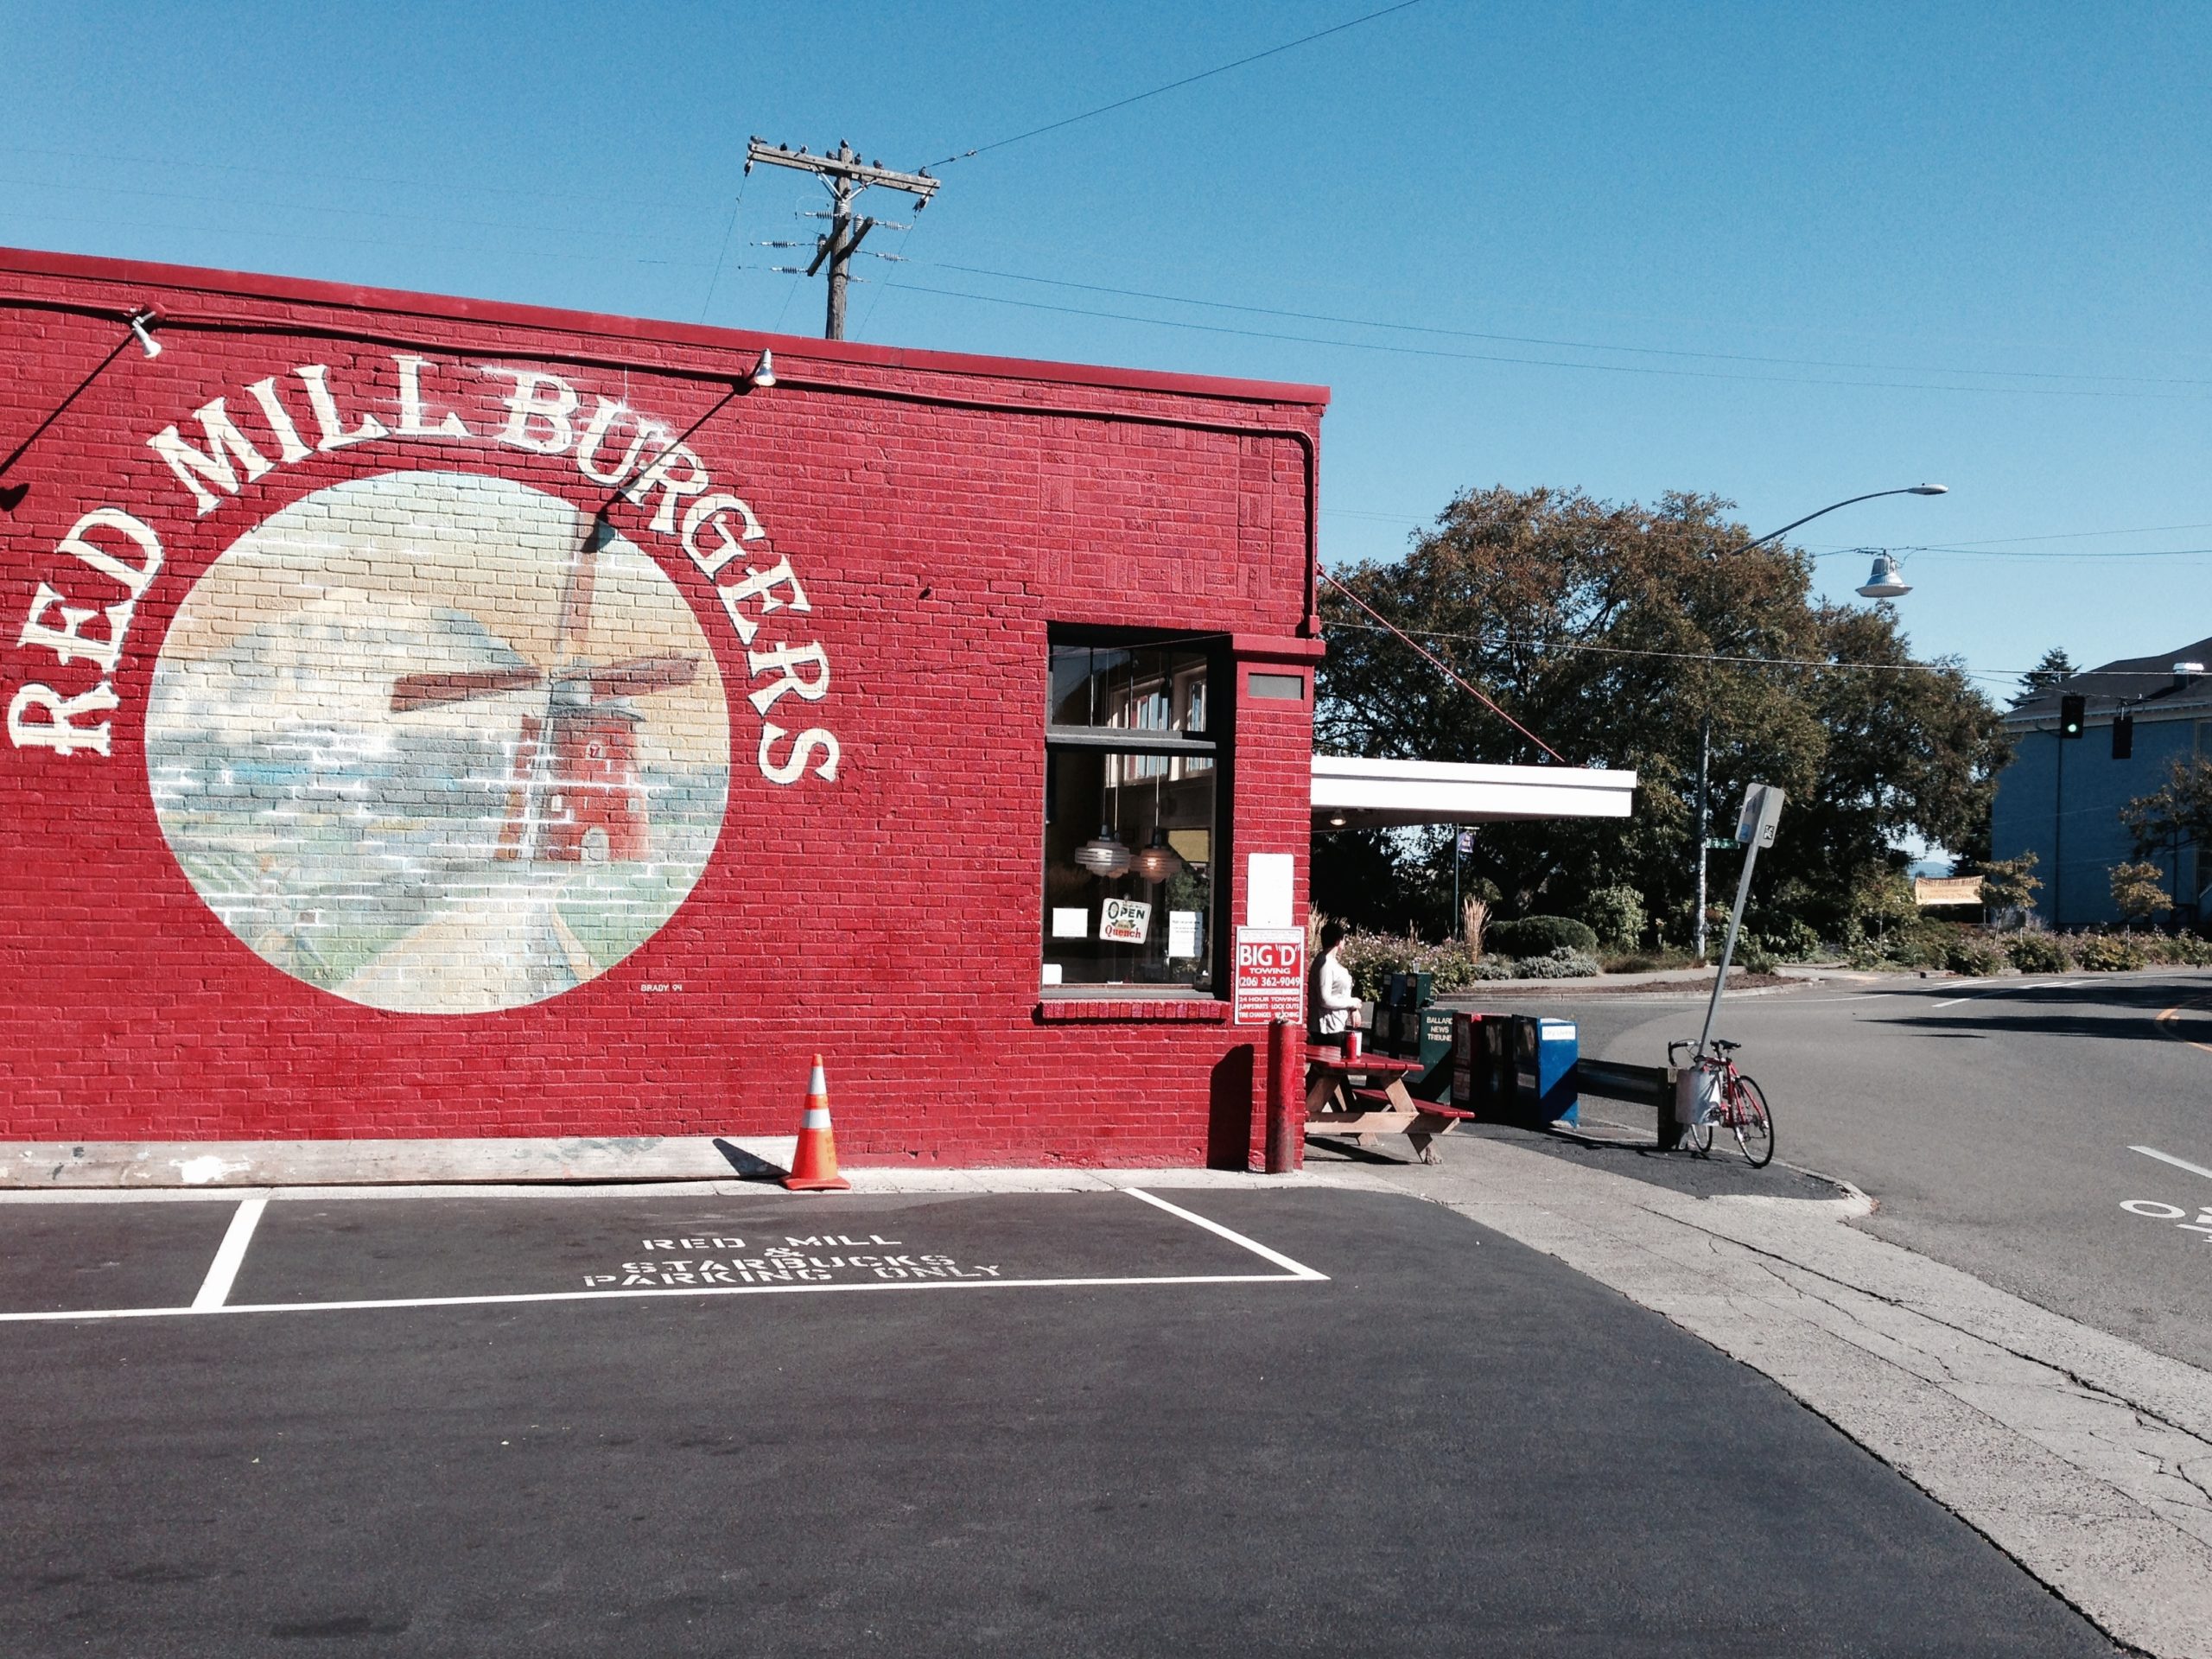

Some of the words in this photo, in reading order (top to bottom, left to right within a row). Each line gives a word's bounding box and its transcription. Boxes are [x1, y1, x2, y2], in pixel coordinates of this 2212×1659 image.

[7, 505, 164, 757] RED
[145, 354, 471, 517] MILL
[485, 366, 841, 785] BURGERS
[1108, 901, 1145, 919] OPEN
[1105, 925, 1141, 938] Quench
[1240, 944, 1272, 966] BIG
[1261, 976, 1300, 986] 362-9049
[642, 1237, 747, 1249] RED
[785, 1235, 902, 1246] MILL
[764, 1247, 804, 1257] &
[621, 1255, 956, 1274] STARBUCKS
[583, 1269, 833, 1287] PARKING
[874, 1265, 1001, 1279] ONLY
